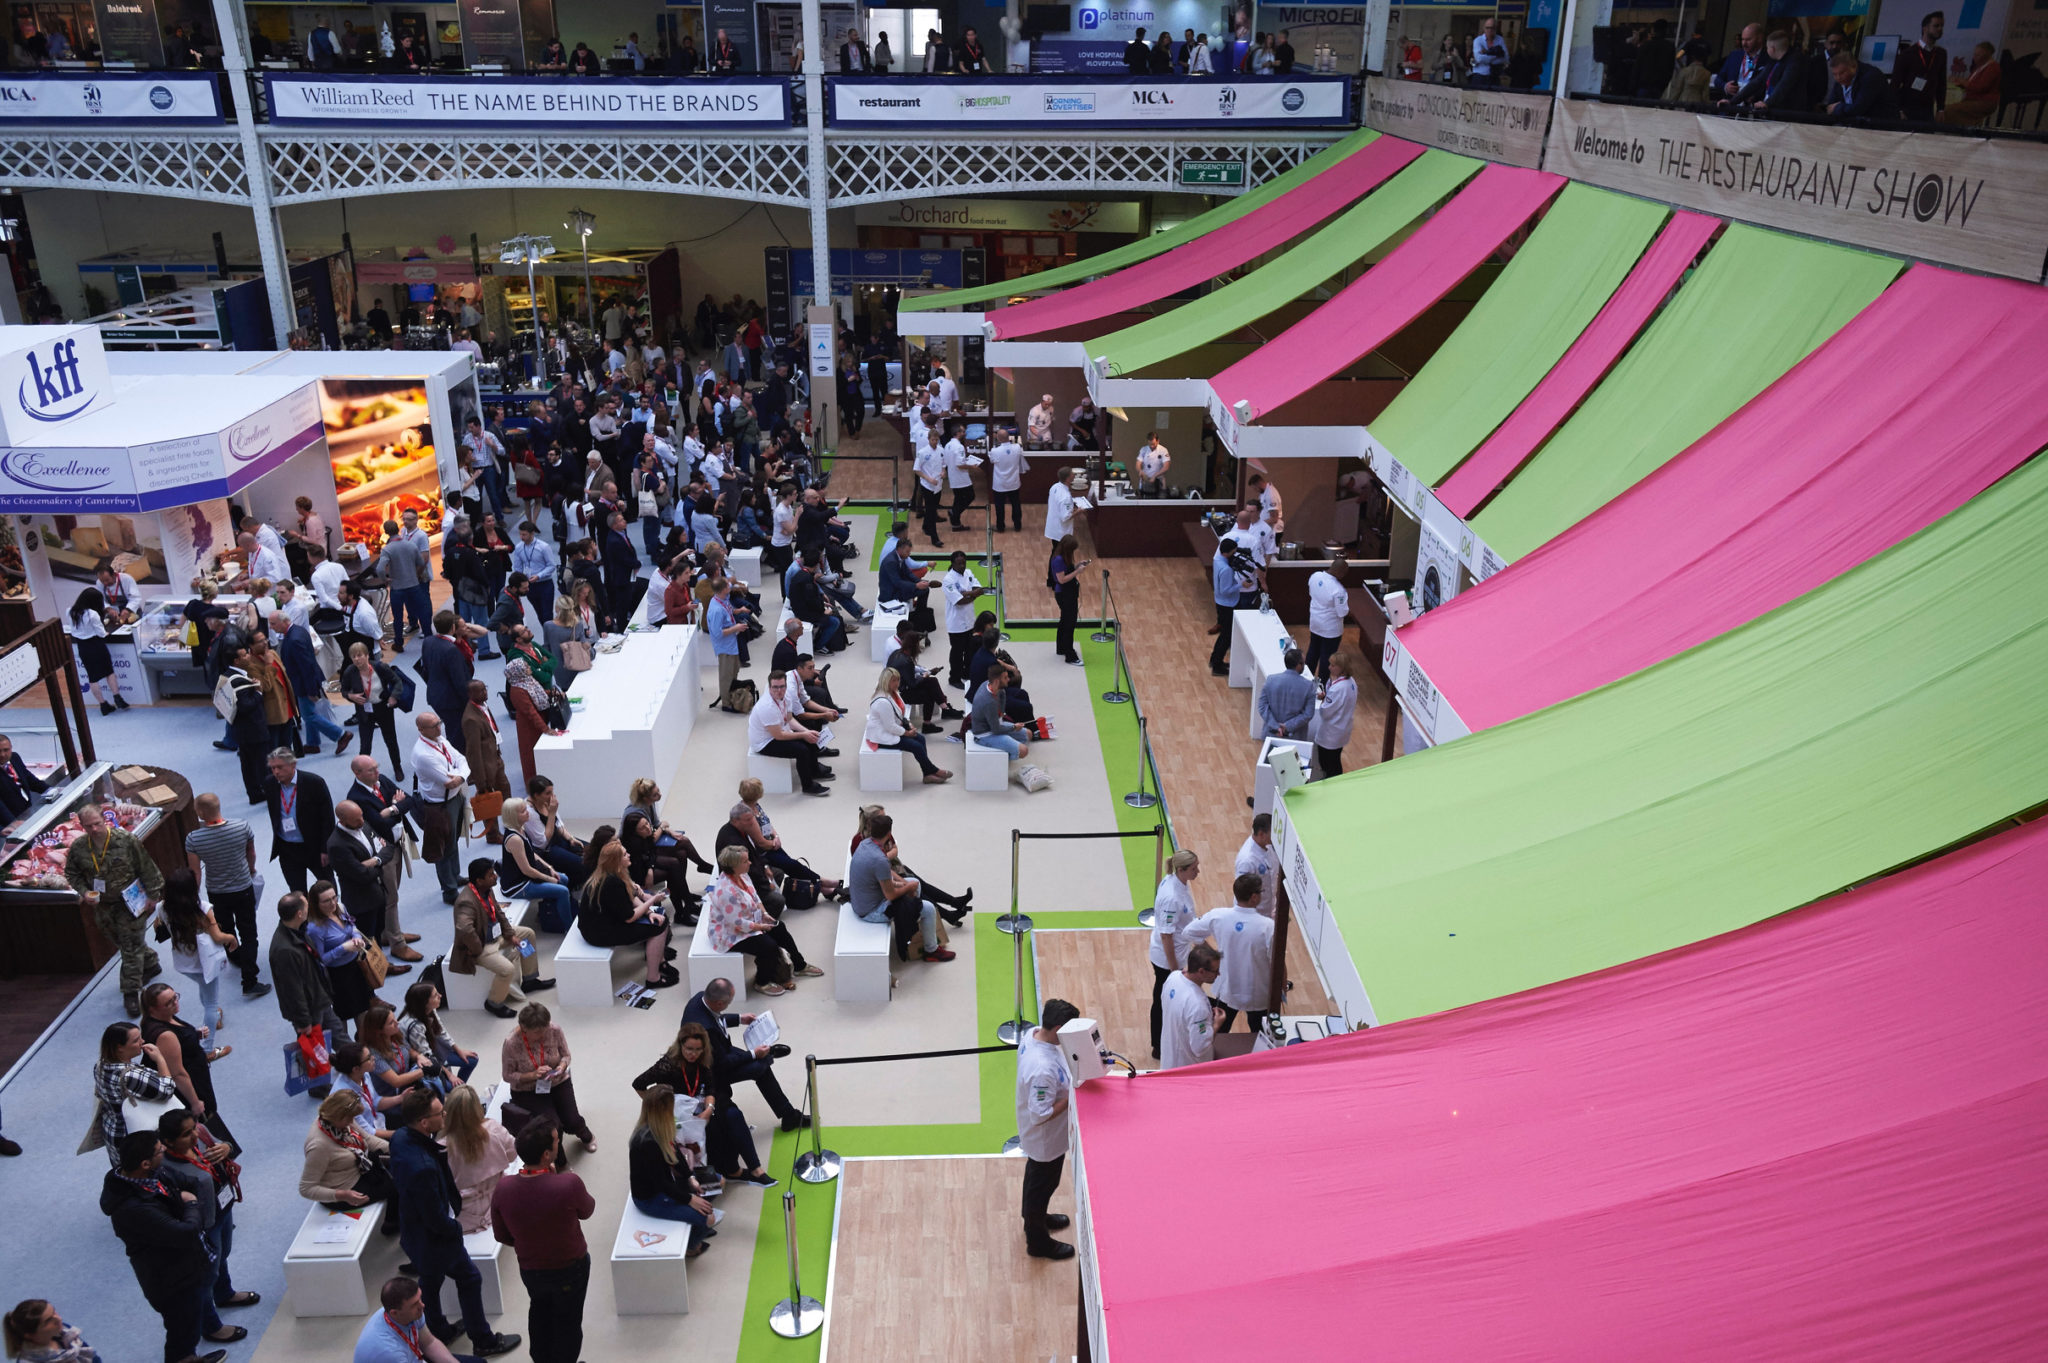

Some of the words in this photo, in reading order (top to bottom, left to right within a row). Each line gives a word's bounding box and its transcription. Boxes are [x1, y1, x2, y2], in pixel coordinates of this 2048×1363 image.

[1100, 9, 1154, 23] platinum
[84, 85, 102, 101] 50
[301, 87, 369, 105] William
[371, 88, 415, 106] Reed
[427, 93, 468, 110] THE
[475, 94, 537, 111] NAME
[543, 94, 622, 112] BEHIND
[626, 95, 667, 112] THE
[673, 95, 759, 112] BRANDS
[1218, 89, 1237, 104] 50
[859, 98, 921, 108] restaurant
[1184, 163, 1225, 171] EMERGENCY
[1226, 163, 1242, 171] EXIT
[1574, 125, 1629, 161] Welcome
[1630, 137, 1646, 165] to
[1659, 138, 1696, 180] THE
[1697, 146, 1866, 211] RESTAURANT
[1866, 167, 1986, 229] SHOW
[901, 204, 969, 225] Orchard
[26, 338, 84, 409] kff
[149, 445, 155, 453] A
[157, 441, 192, 453] selection
[192, 438, 201, 446] of
[234, 424, 272, 450] Excellence
[13, 452, 111, 478] Excellence
[139, 454, 176, 468] specialist
[176, 452, 192, 461] fine
[192, 447, 214, 459] foods
[148, 469, 154, 477] &
[155, 461, 199, 477] ingredients
[199, 459, 210, 468] for
[149, 475, 190, 489] discerning
[13, 496, 73, 506] Cheesemakers
[74, 496, 83, 507] of
[85, 496, 136, 507] Canterbury
[1415, 490, 1425, 510] 05
[1461, 535, 1472, 558] 06
[1385, 641, 1397, 668] 07
[1273, 807, 1283, 846] 08
